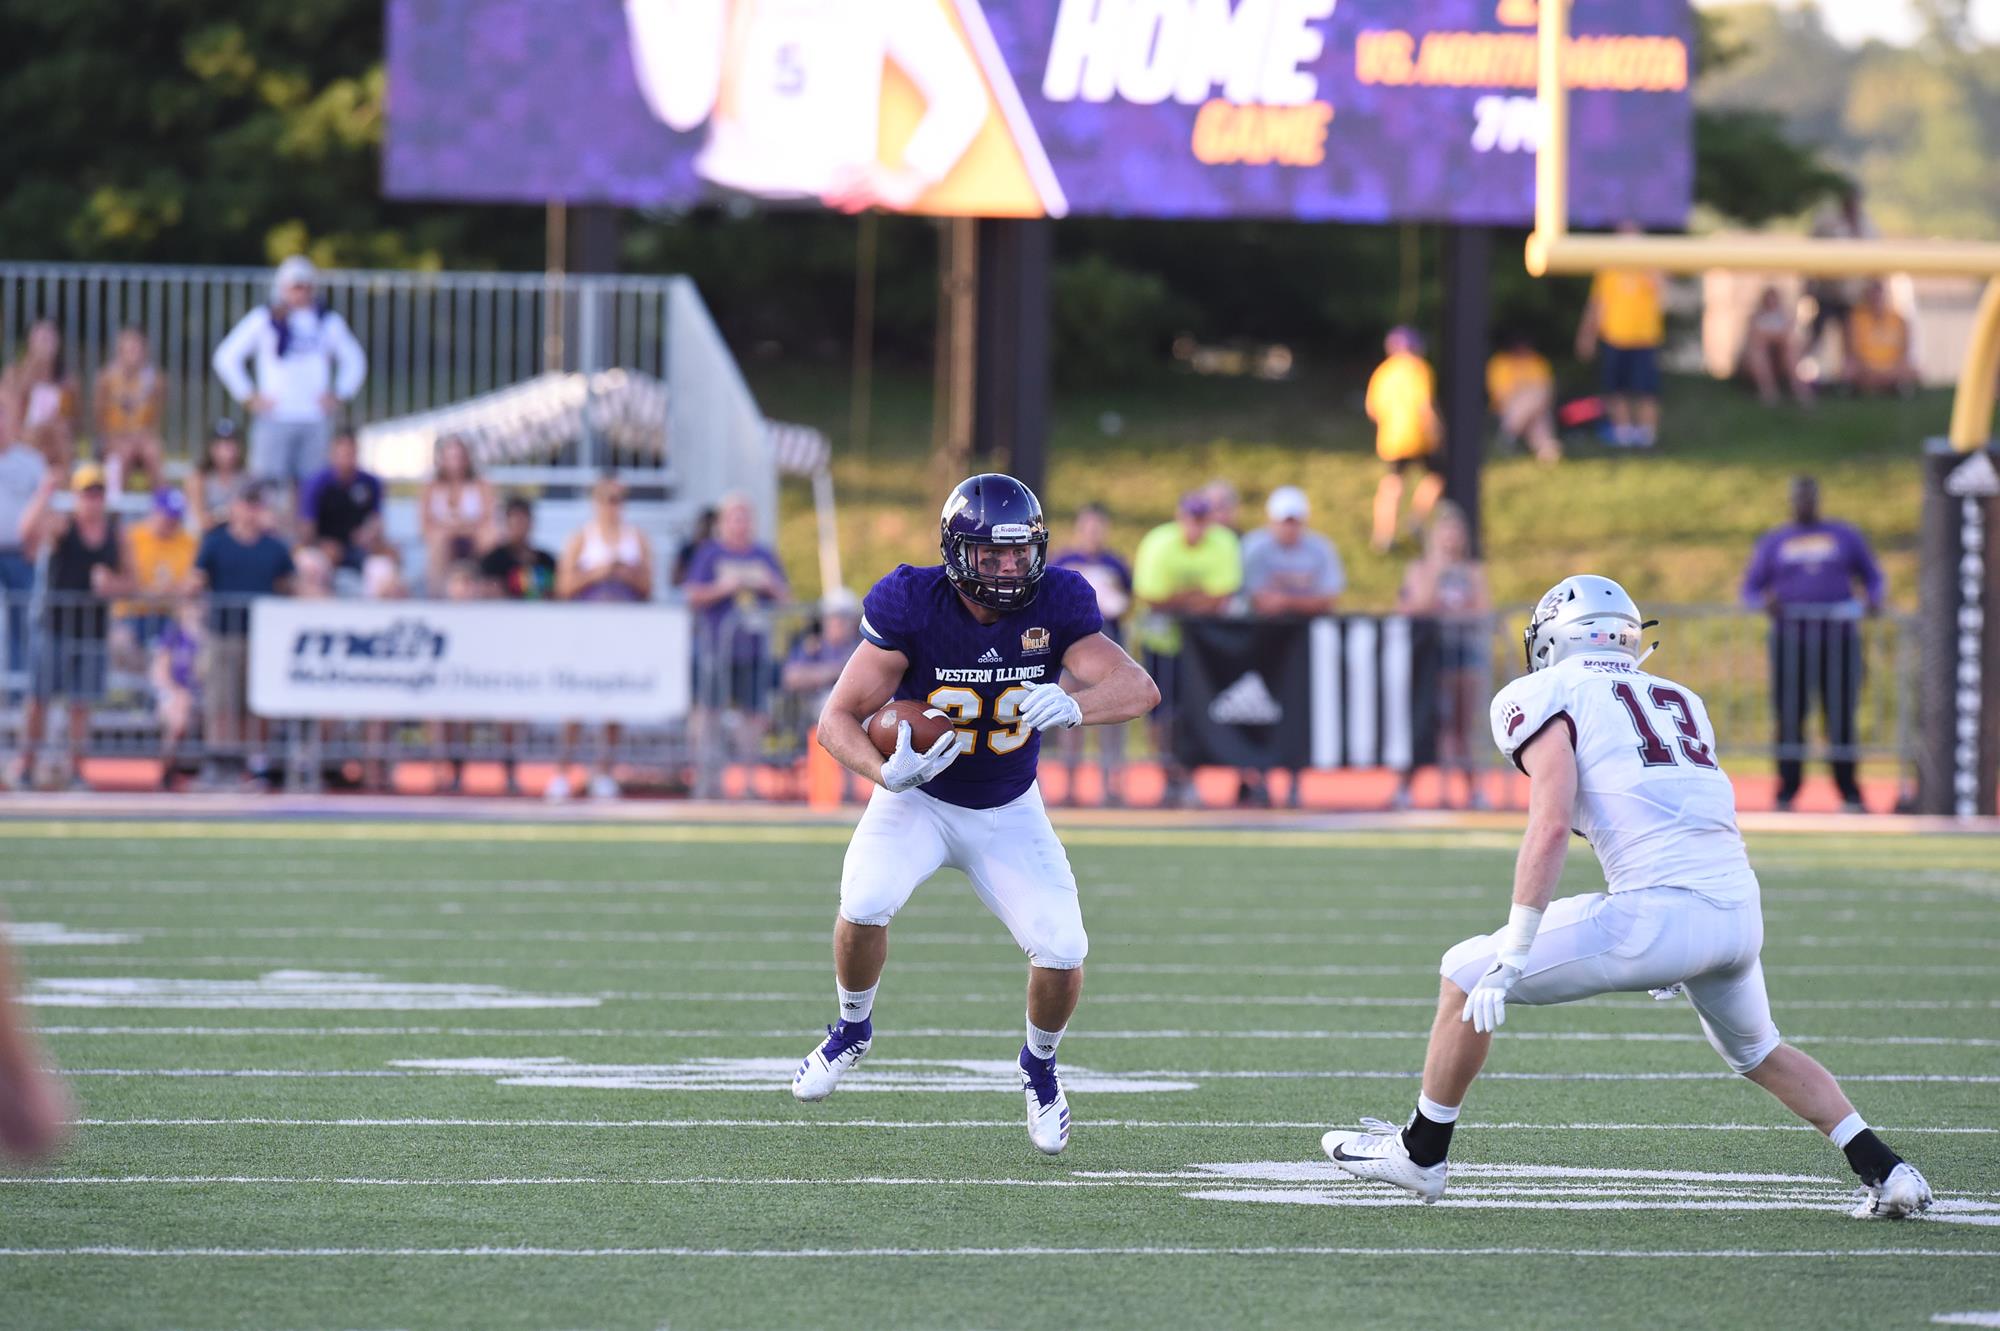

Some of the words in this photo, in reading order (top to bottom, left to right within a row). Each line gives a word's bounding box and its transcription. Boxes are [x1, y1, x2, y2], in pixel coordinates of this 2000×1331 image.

[1042, 0, 1336, 105] HOME
[1191, 98, 1334, 167] GAME
[934, 667, 994, 683] WESTERN
[995, 664, 1046, 682] ILLINOIS
[926, 685, 1033, 756] 29
[1611, 680, 1719, 770] 13
